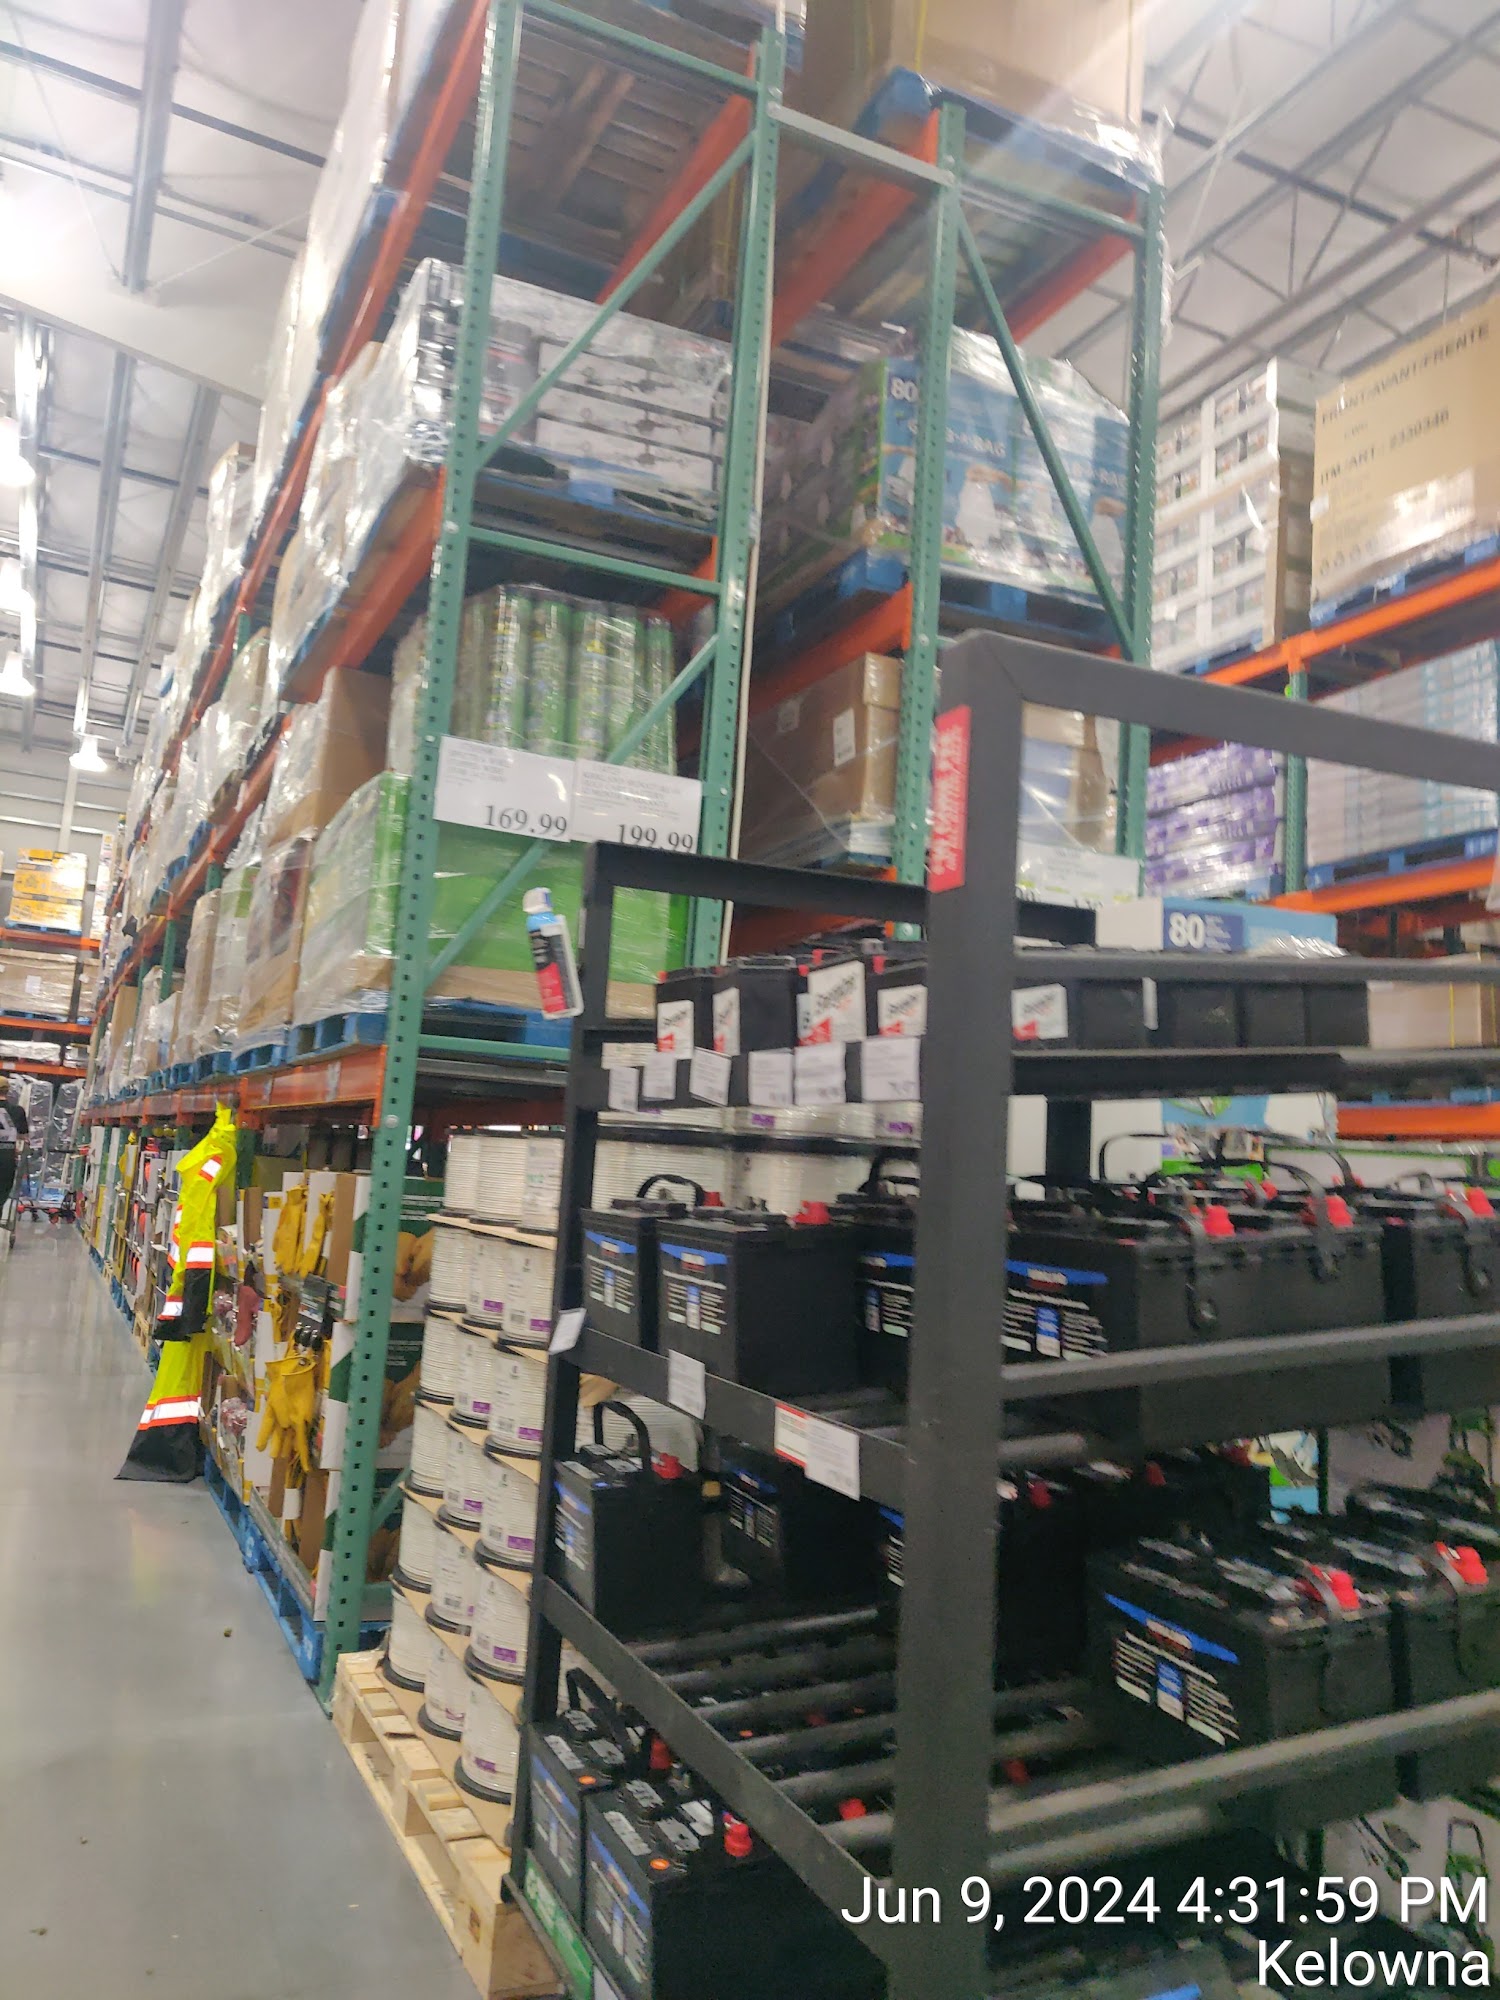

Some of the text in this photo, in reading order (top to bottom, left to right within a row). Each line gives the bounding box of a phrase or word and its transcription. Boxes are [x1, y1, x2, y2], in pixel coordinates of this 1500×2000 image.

[891, 376, 920, 403] 80
[484, 804, 568, 837] 169.99
[1168, 911, 1206, 949] 80
